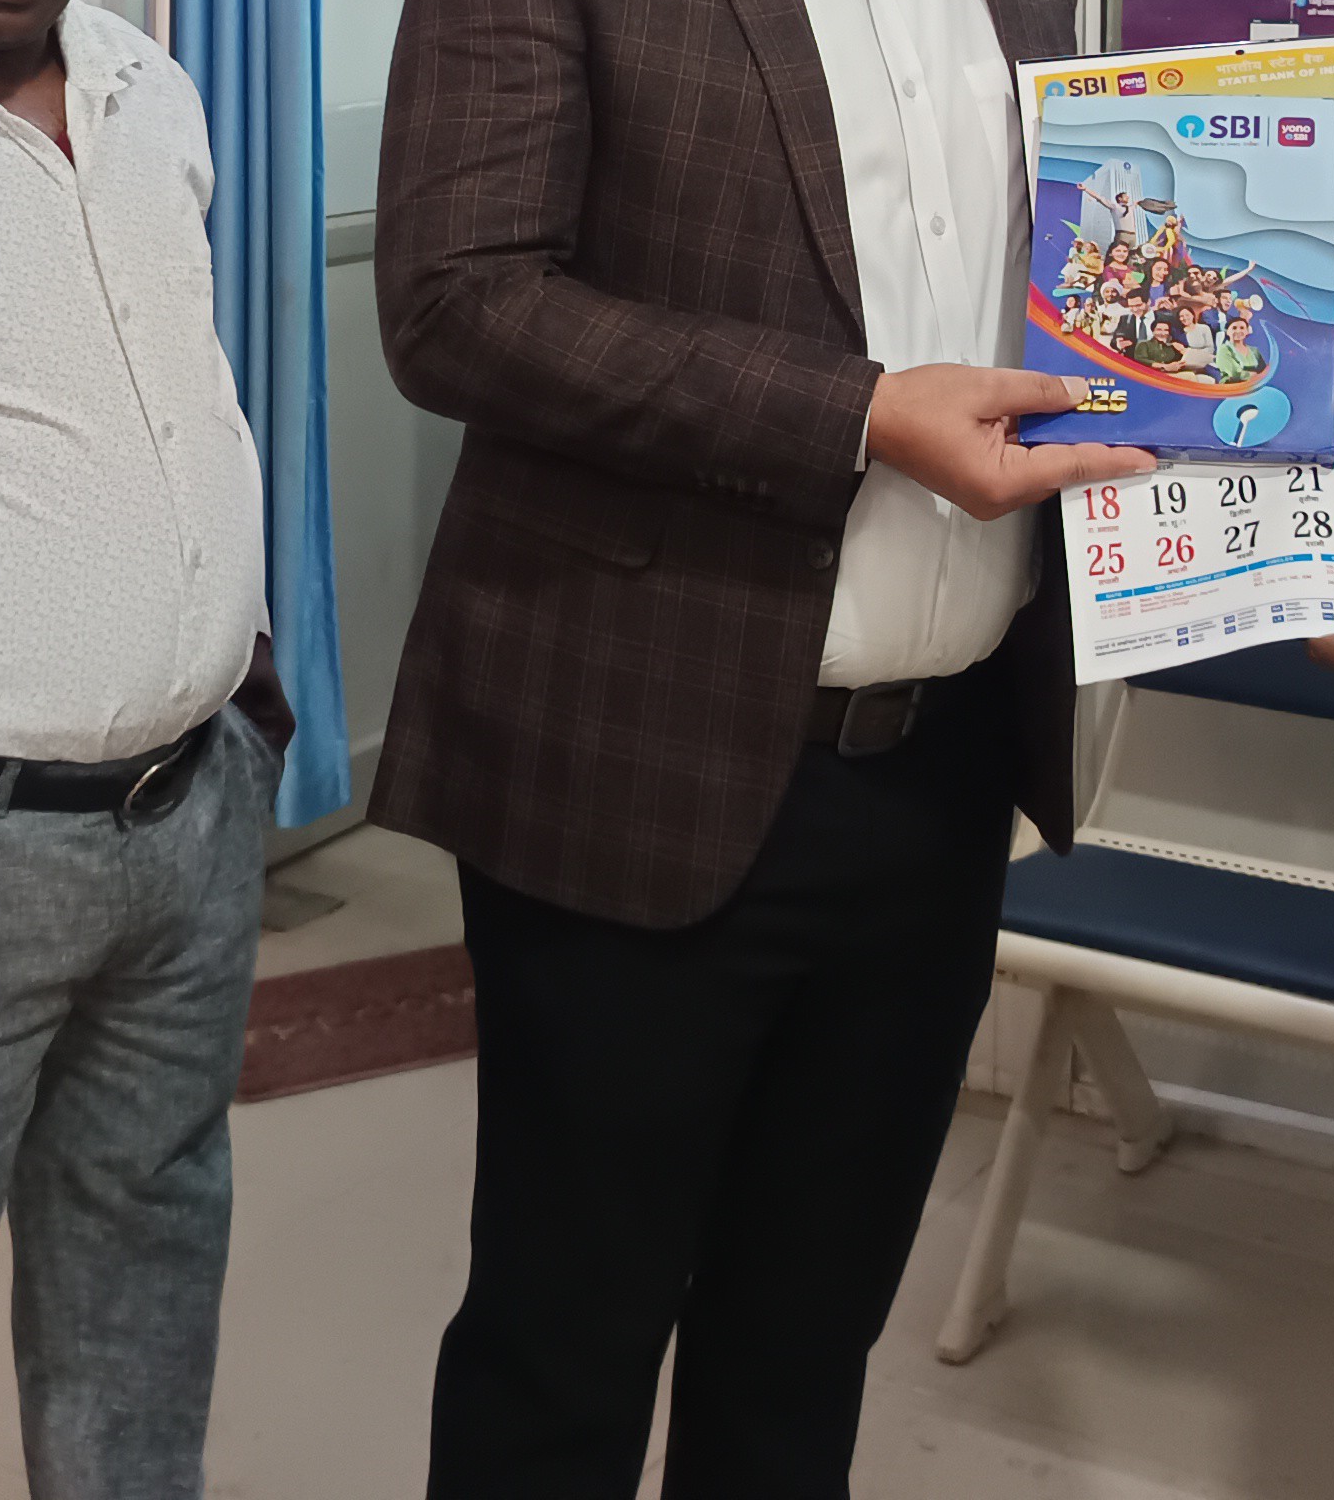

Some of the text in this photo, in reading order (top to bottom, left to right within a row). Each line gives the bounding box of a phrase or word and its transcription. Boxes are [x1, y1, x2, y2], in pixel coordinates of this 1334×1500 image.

[1216, 52, 1326, 74] भारतीय स्टेट बैंक
[1068, 76, 1107, 97] SBI
[1119, 76, 1145, 89] yono
[1217, 74, 1258, 87] STATE
[1260, 71, 1296, 82] BANK
[1299, 67, 1315, 77] OF
[1209, 115, 1261, 139] SBI
[1281, 124, 1312, 134] yono
[1083, 466, 1324, 522] 18 19 20 21
[1086, 542, 1125, 577] 25
[1156, 534, 1195, 568] 26
[1224, 520, 1261, 554] 27
[1292, 510, 1333, 539] 28
